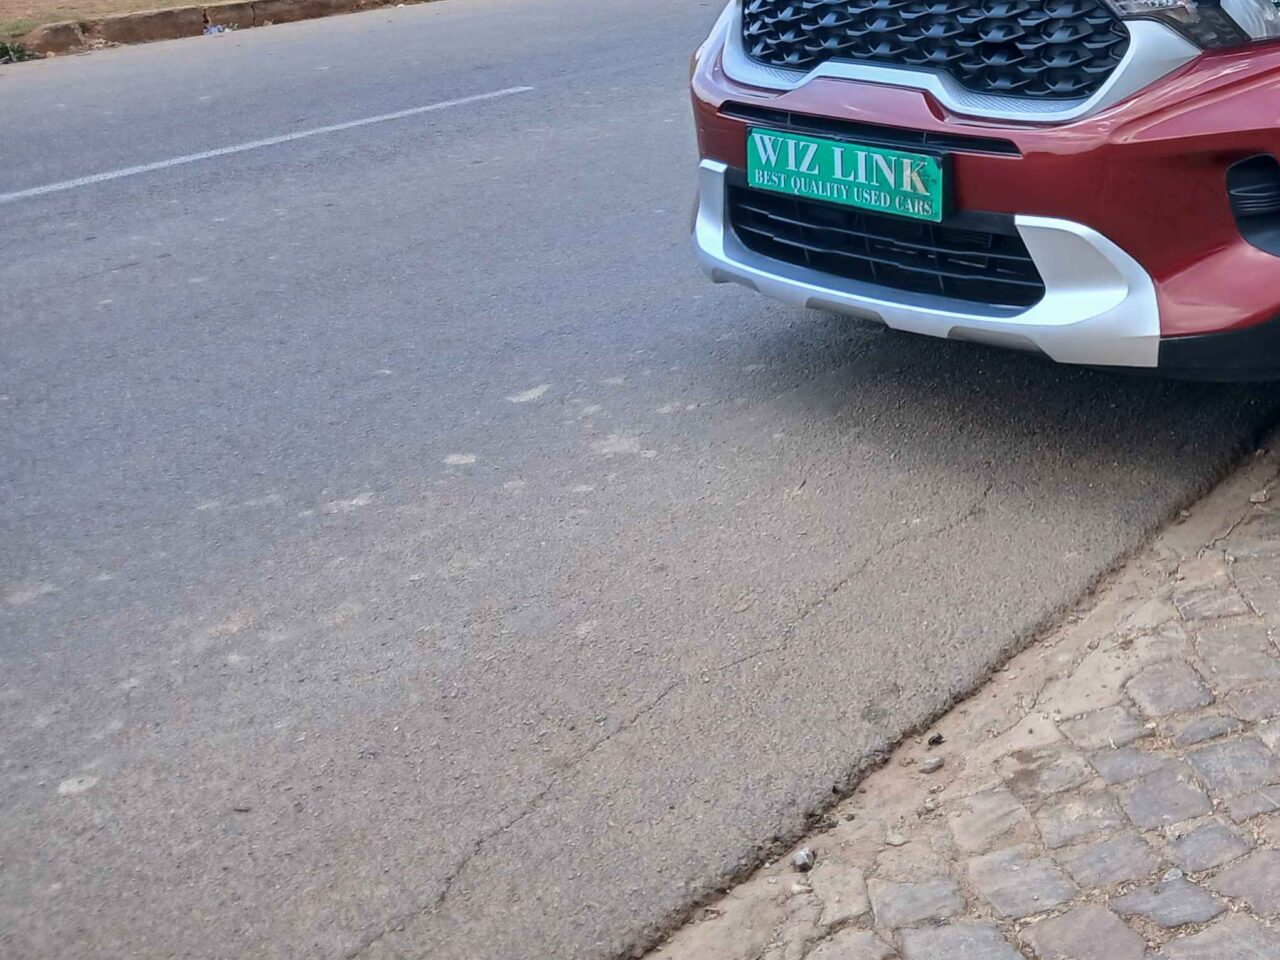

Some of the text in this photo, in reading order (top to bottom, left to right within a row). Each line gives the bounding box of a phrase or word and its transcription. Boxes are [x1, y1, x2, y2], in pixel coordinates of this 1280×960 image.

[752, 133, 931, 196] WIZ LINK
[755, 168, 933, 216] BEST QUALITY USED CARS
